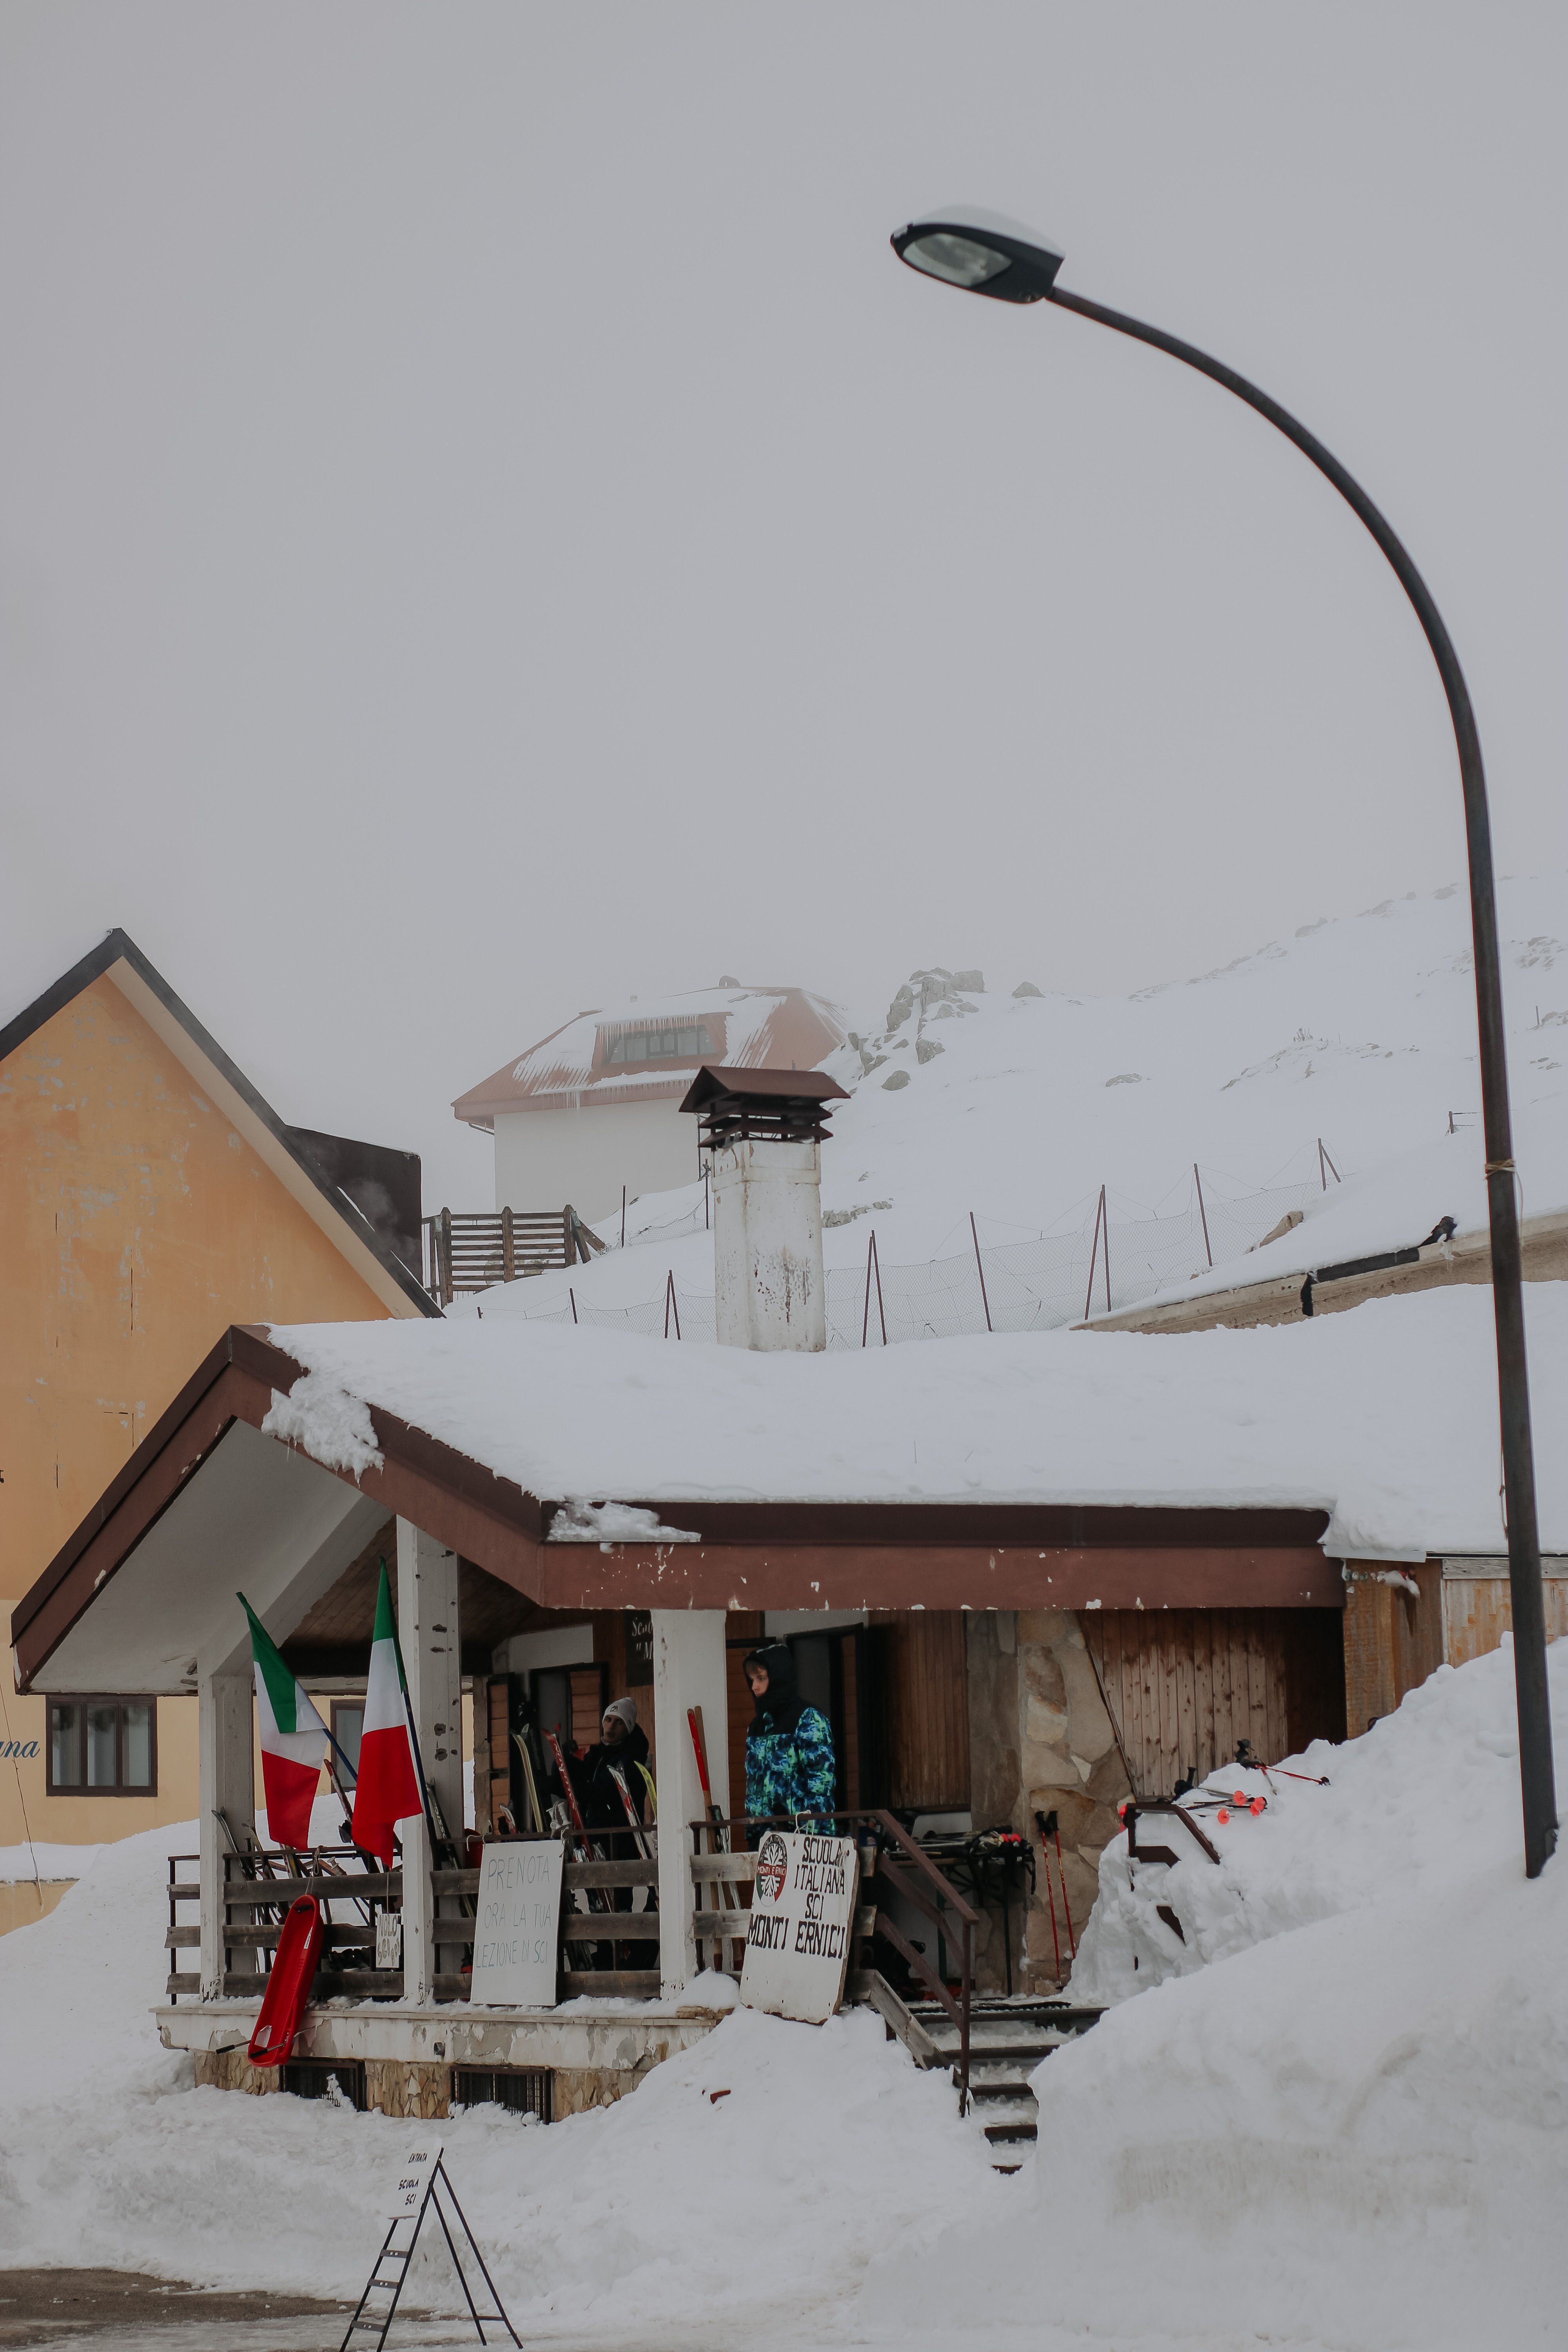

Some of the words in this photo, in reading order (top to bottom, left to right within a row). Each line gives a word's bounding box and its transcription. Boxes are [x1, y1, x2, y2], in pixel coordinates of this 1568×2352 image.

[802, 1837, 844, 1867] SCUOLA
[487, 1856, 550, 1891] PRENOTA
[771, 1867, 786, 1876] ERNICI
[794, 1864, 844, 1895] ITALIANA
[484, 1903, 506, 1929] ORA
[514, 1904, 526, 1927] LA
[534, 1904, 552, 1927] TUA
[805, 1893, 824, 1920] SCI
[379, 1915, 397, 1936] NOLO
[747, 1913, 789, 1950] MONTI
[795, 1921, 845, 1959] ERNICI
[476, 1940, 518, 1968] LEZIONE
[522, 1940, 529, 1962] DI
[534, 1940, 548, 1964] SCI
[408, 2153, 427, 2163] ENTRATA
[398, 2178, 419, 2190] SCUOLA
[405, 2194, 417, 2205] SCI
